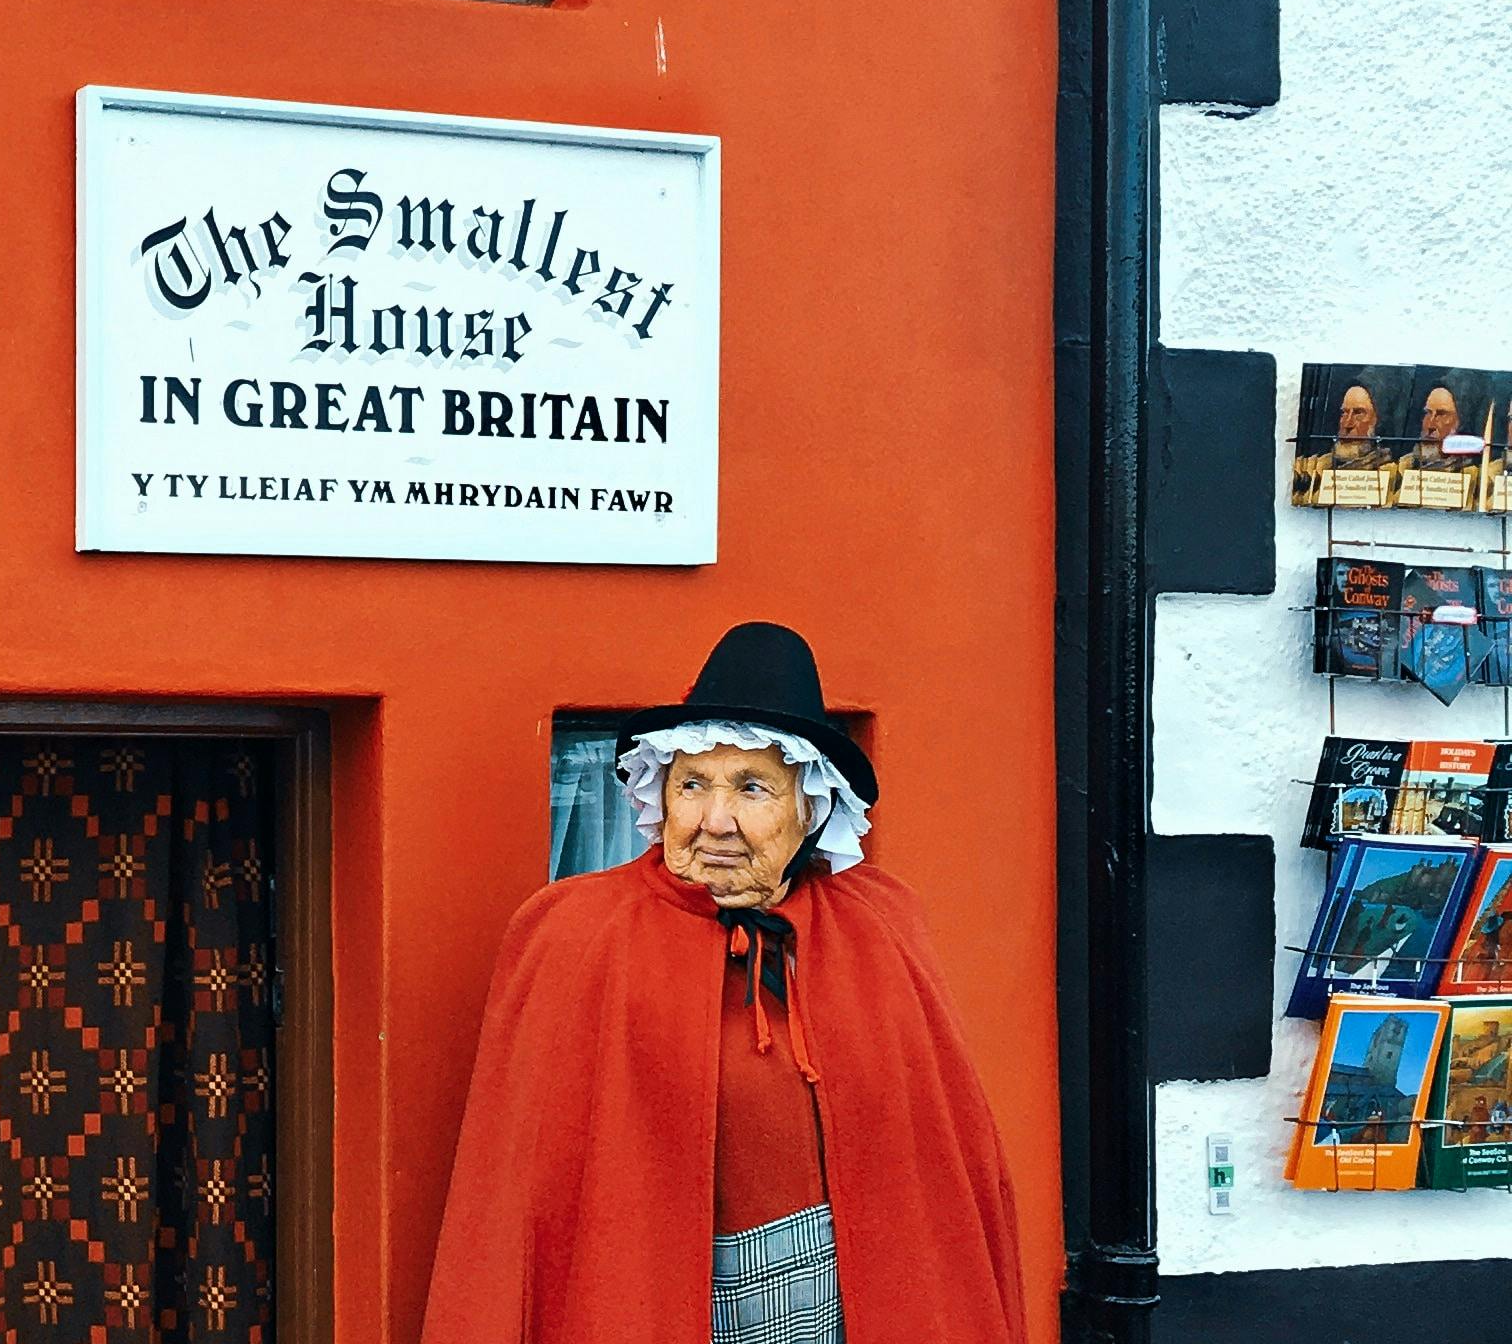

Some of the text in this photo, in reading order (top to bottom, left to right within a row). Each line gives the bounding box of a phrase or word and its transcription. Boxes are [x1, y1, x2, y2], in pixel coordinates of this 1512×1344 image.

[140, 169, 674, 339] The Smallest
[296, 272, 533, 363] House
[139, 375, 670, 444] IN GREAT BRITAIN
[131, 473, 673, 513] Y TY LLEIAF YM MHRYDAIN FAWR
[1344, 587, 1391, 607] Conway
[1348, 567, 1389, 587] Ghosts
[1340, 743, 1389, 764] Pearl
